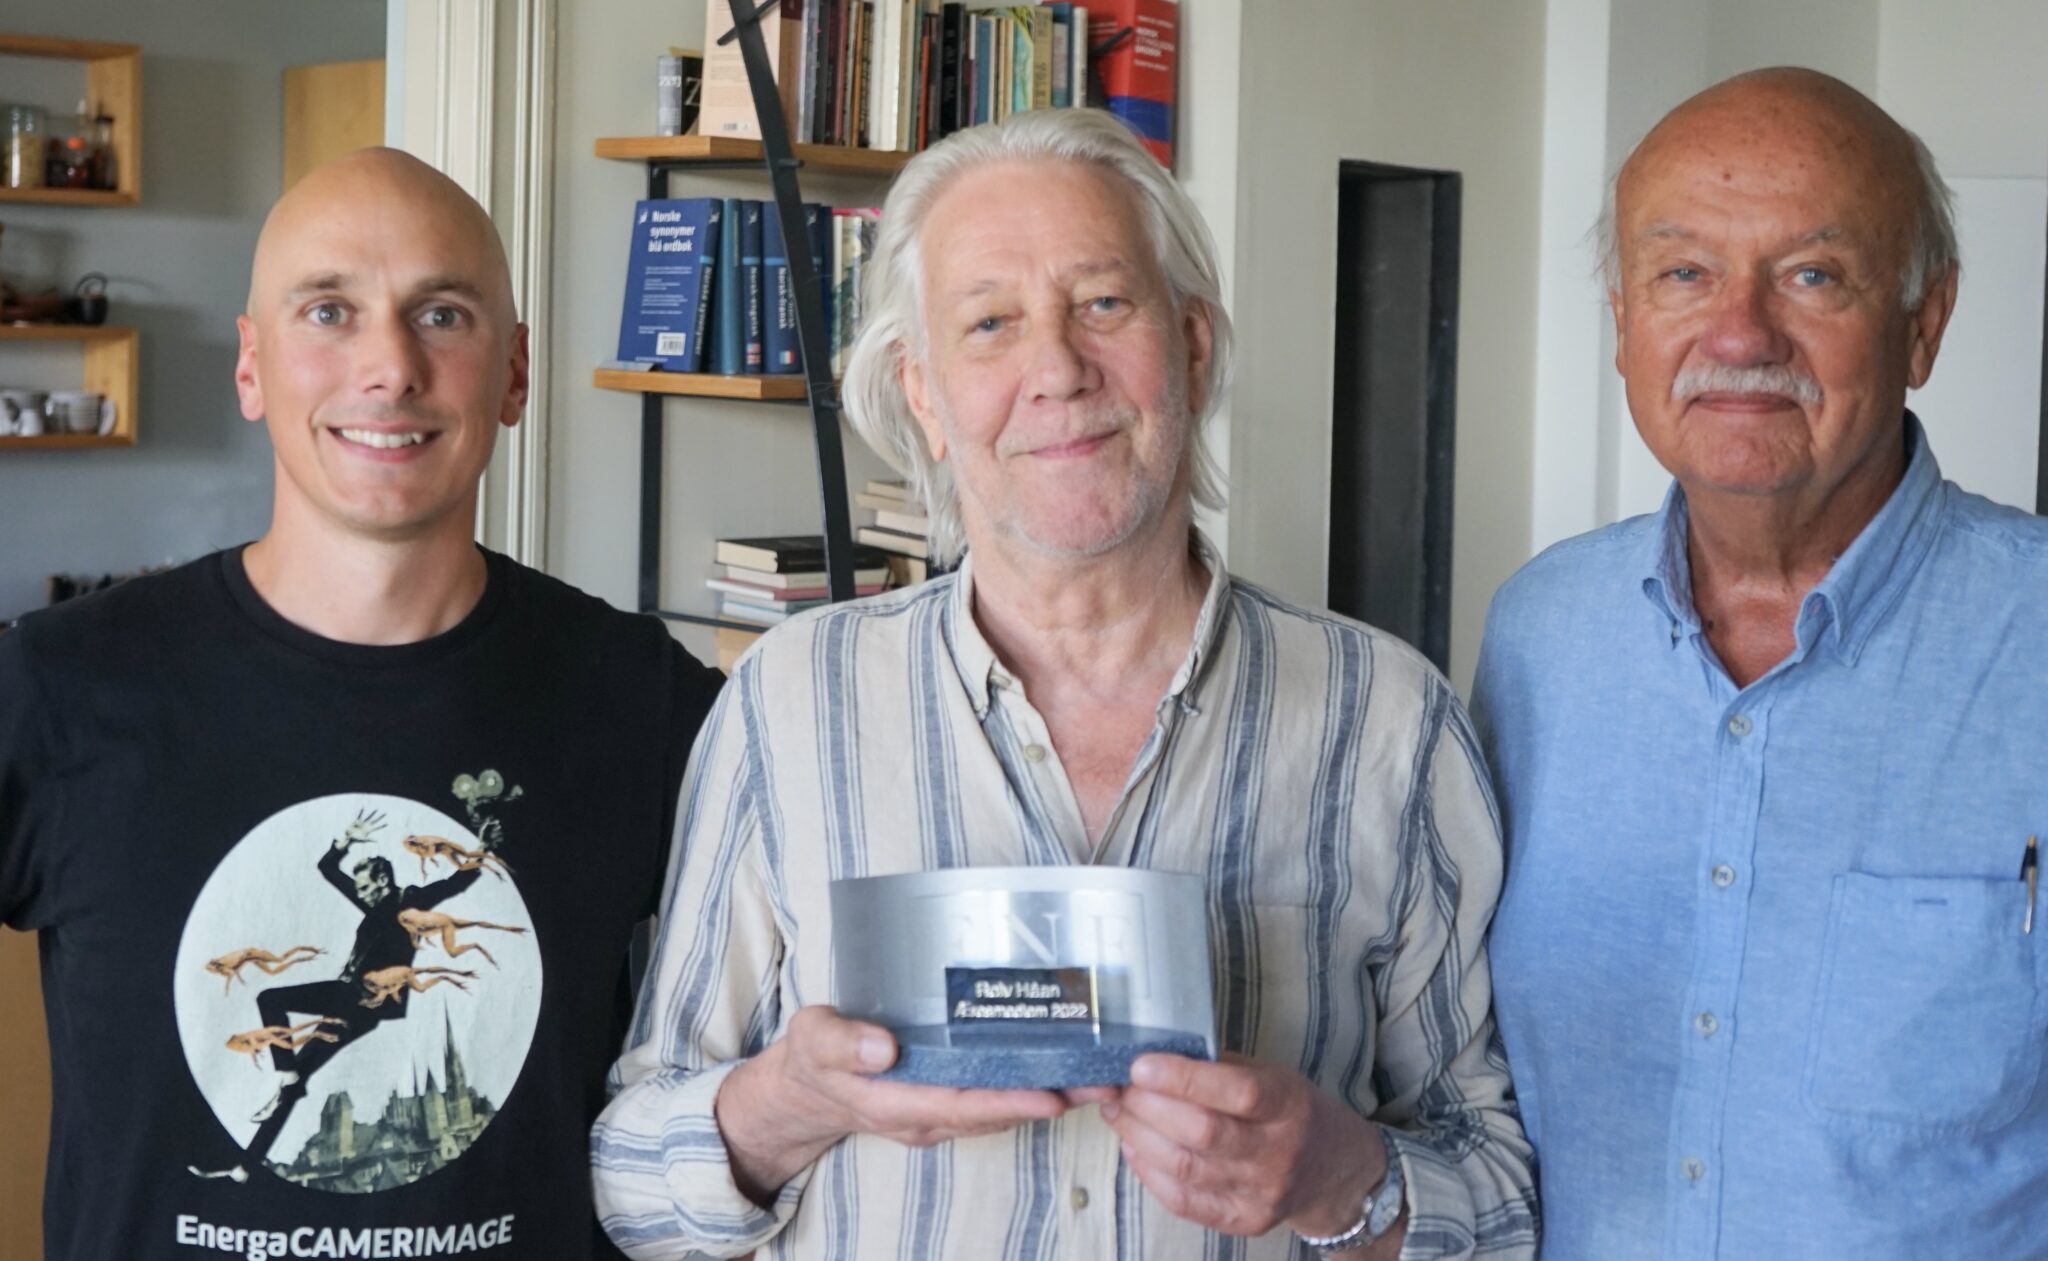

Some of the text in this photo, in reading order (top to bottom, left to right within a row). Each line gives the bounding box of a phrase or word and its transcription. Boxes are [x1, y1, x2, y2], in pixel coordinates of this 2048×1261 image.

[652, 210, 681, 222] Norske
[650, 226, 696, 238] synonymer
[648, 240, 692, 252] blå ordbok
[695, 266, 712, 355] Norske synonymer
[1050, 1002, 1089, 1018] 2022
[176, 1214, 515, 1261] EnergaCAMERIMAGE
